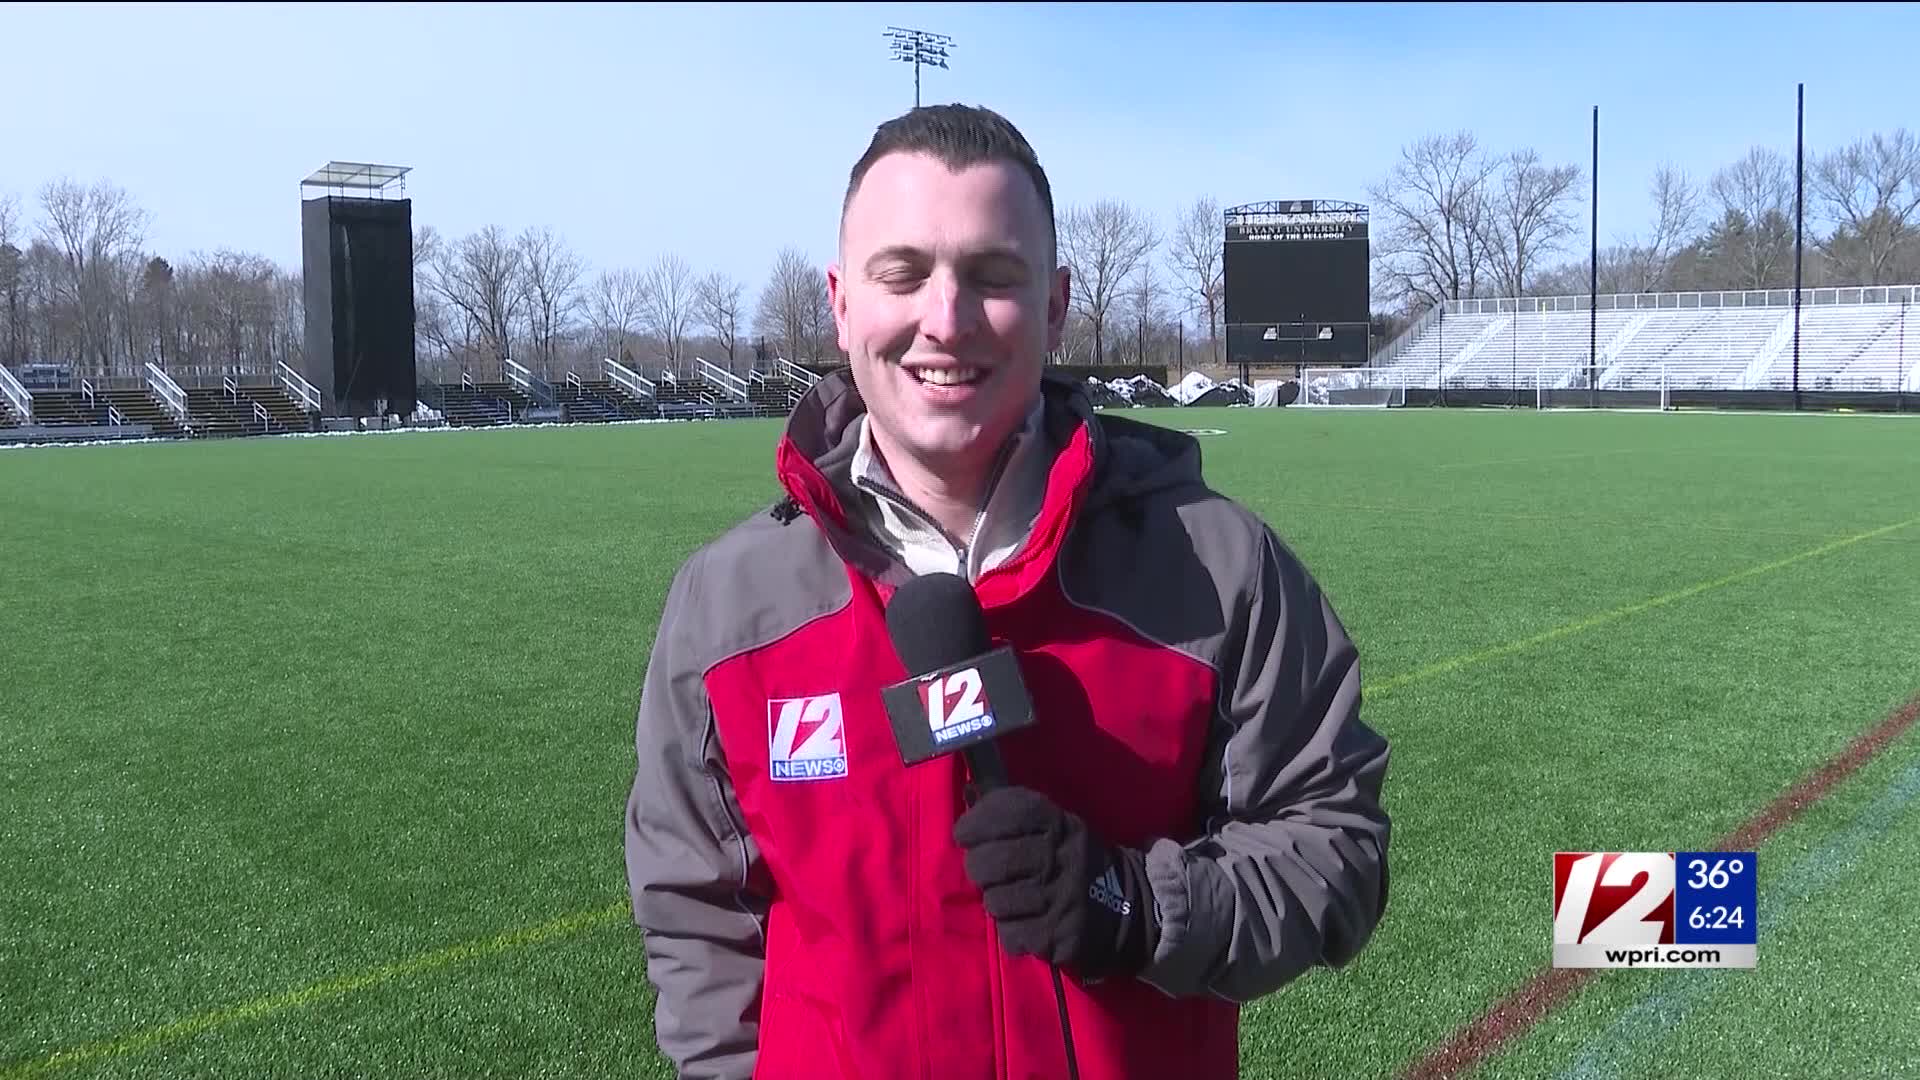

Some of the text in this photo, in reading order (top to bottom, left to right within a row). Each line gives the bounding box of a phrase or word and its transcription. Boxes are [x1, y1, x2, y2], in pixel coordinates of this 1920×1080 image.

[1239, 224, 1354, 235] BRYANT UNIVERSITY
[1303, 232, 1345, 240] BULLDOGS
[927, 667, 985, 732] 12
[772, 694, 842, 760] 12
[935, 720, 982, 745] NEWS
[775, 760, 835, 778] NEWS
